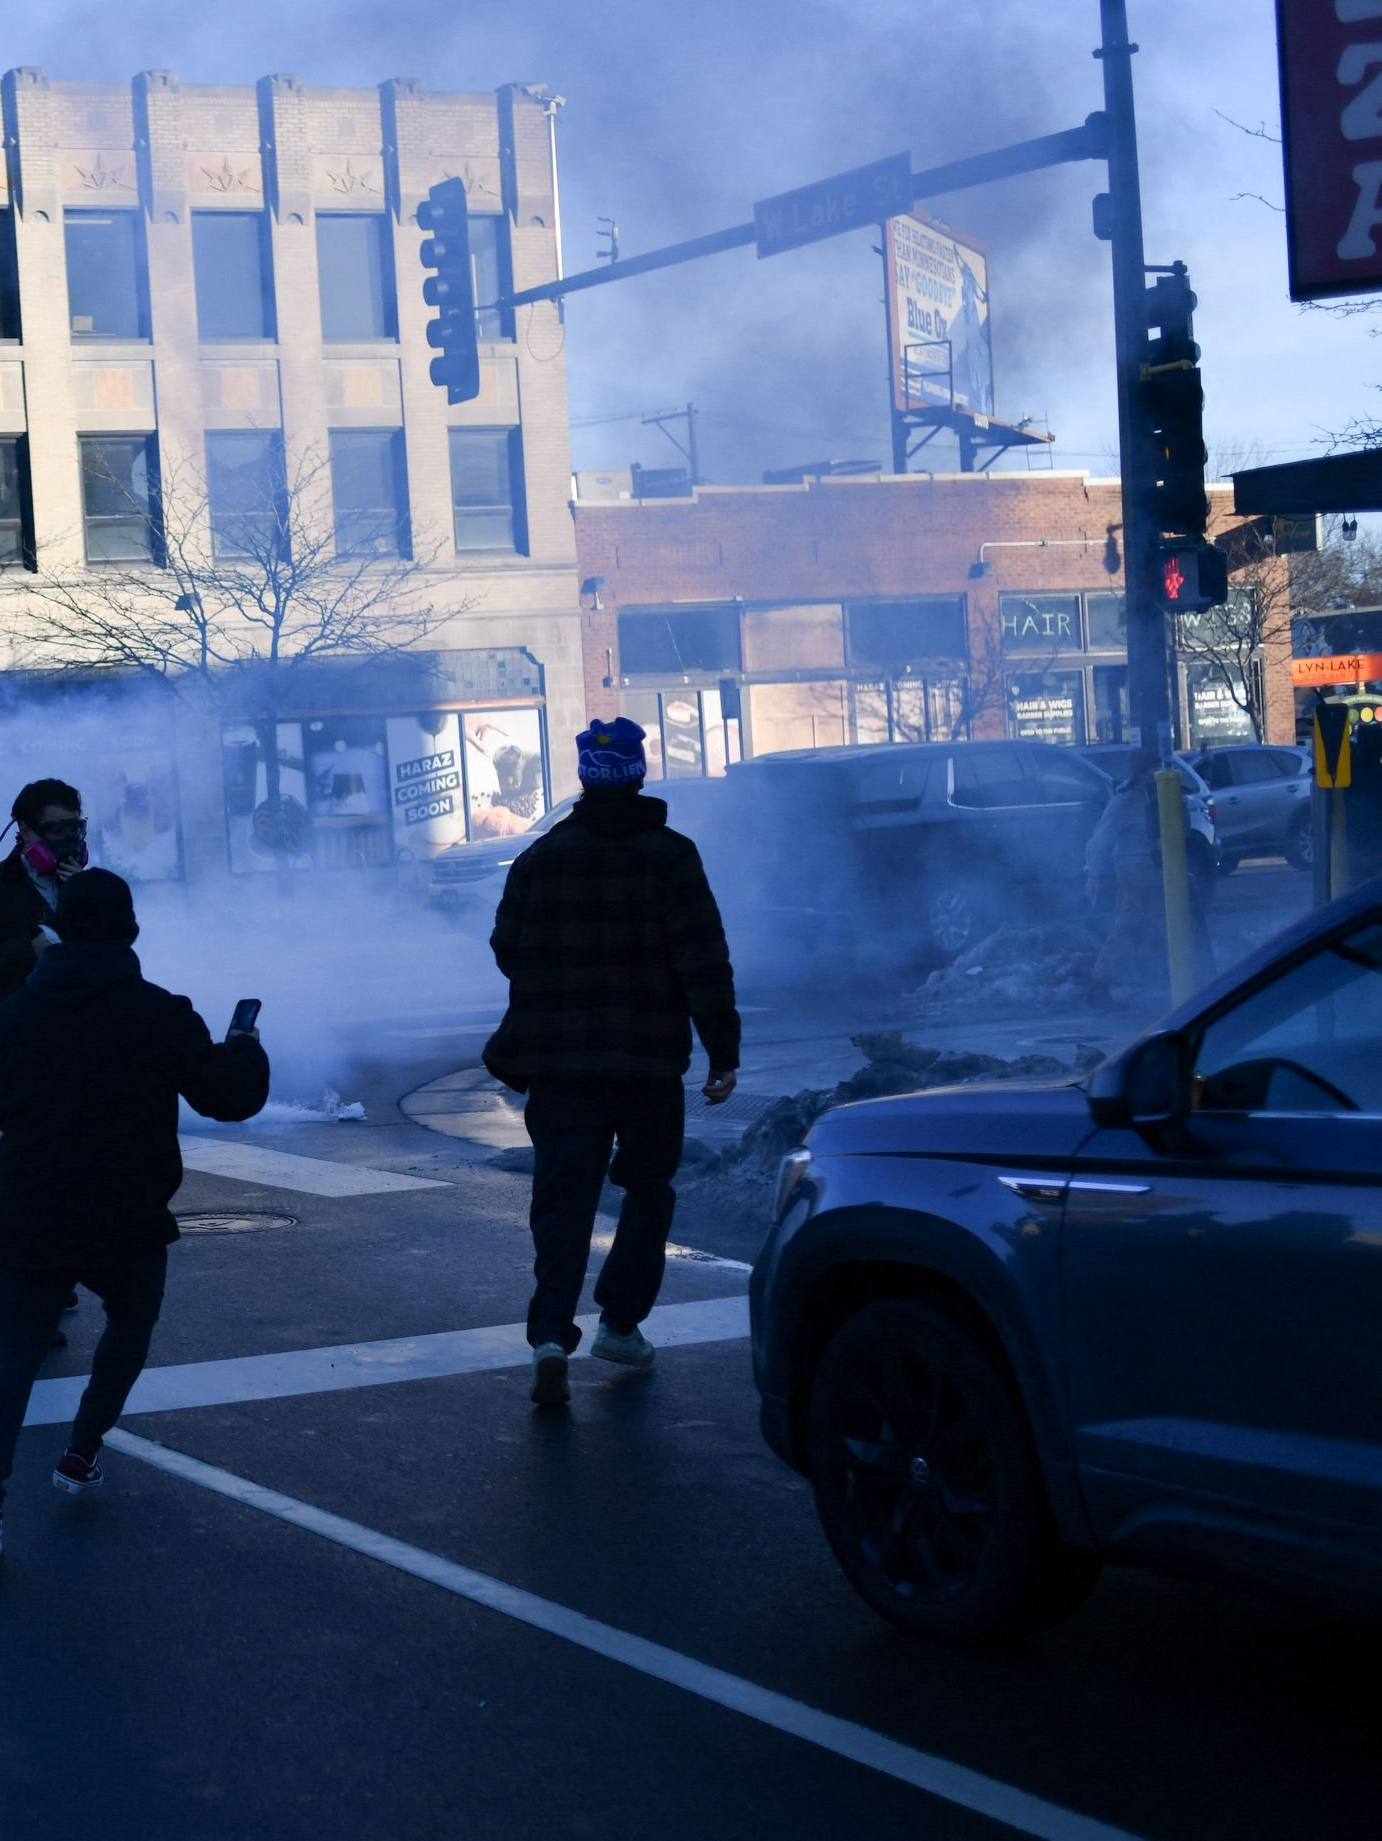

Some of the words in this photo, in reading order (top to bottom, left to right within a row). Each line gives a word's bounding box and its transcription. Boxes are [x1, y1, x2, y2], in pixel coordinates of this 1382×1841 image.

[792, 191, 858, 232] Lake
[912, 247, 956, 285] MINNESOTANS
[906, 296, 932, 336] Blue
[934, 308, 949, 342] Ox
[1001, 613, 1071, 637] HAIR
[1016, 701, 1038, 711] HAIR
[1048, 699, 1073, 709] WIGS
[400, 752, 452, 778] HARAZ
[398, 774, 457, 801] COMING
[408, 798, 450, 821] SOON
